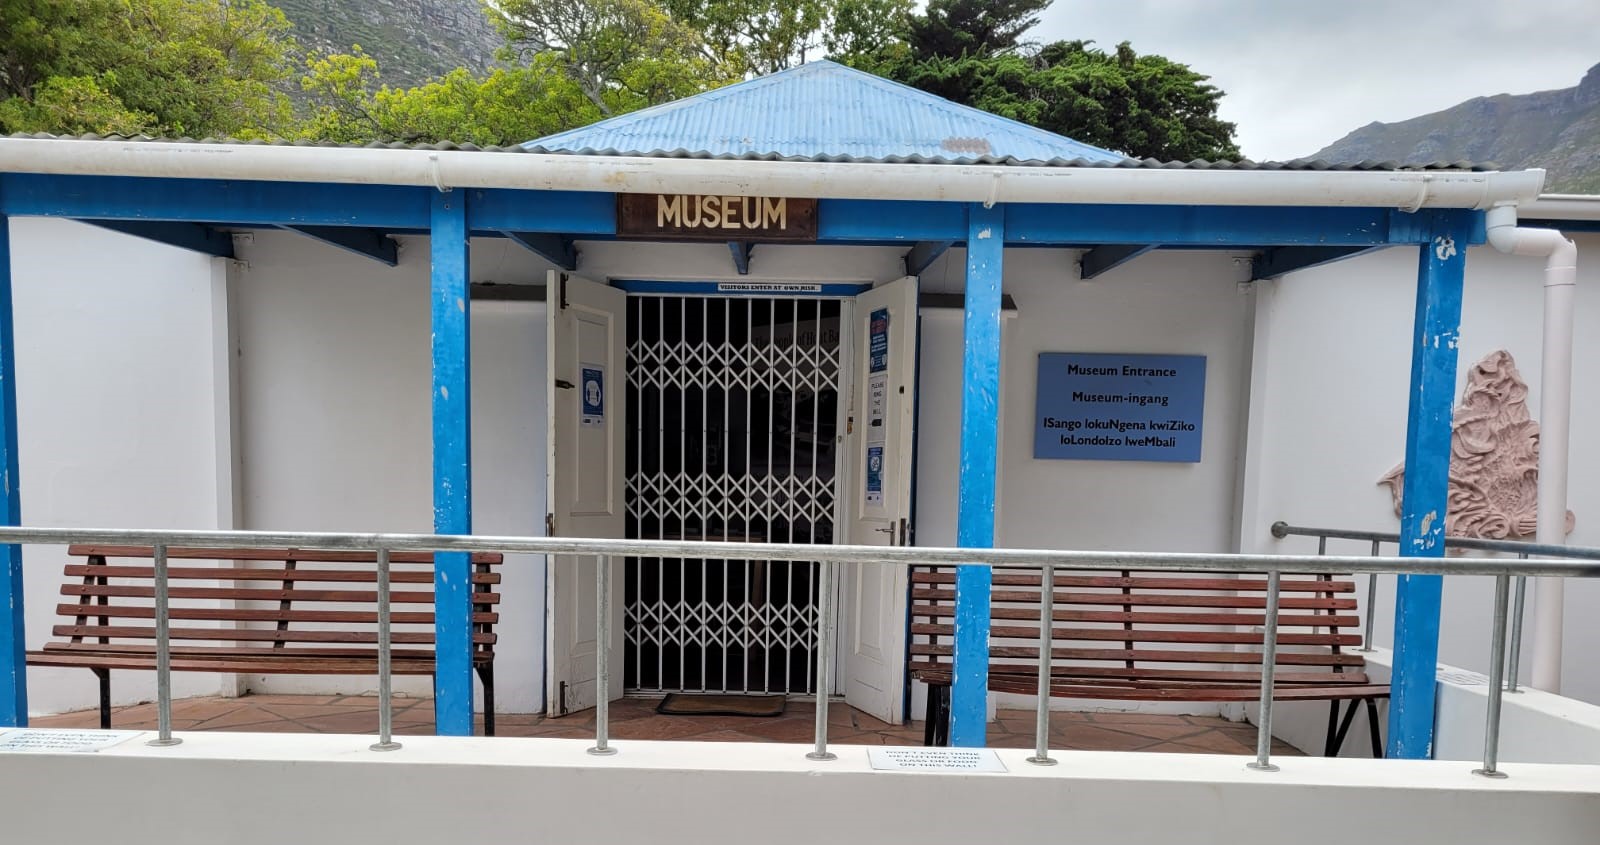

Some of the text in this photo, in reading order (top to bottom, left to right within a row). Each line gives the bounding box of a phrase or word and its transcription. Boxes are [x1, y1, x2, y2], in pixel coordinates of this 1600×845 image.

[657, 194, 787, 230] MUSEUM
[1067, 364, 1177, 377] Museum Entrance
[1072, 391, 1169, 407] Museum-ingang
[1043, 417, 1196, 432] ISango lokuNgena kwiZiko
[1060, 434, 1176, 448] loLondolzo lweMbali
